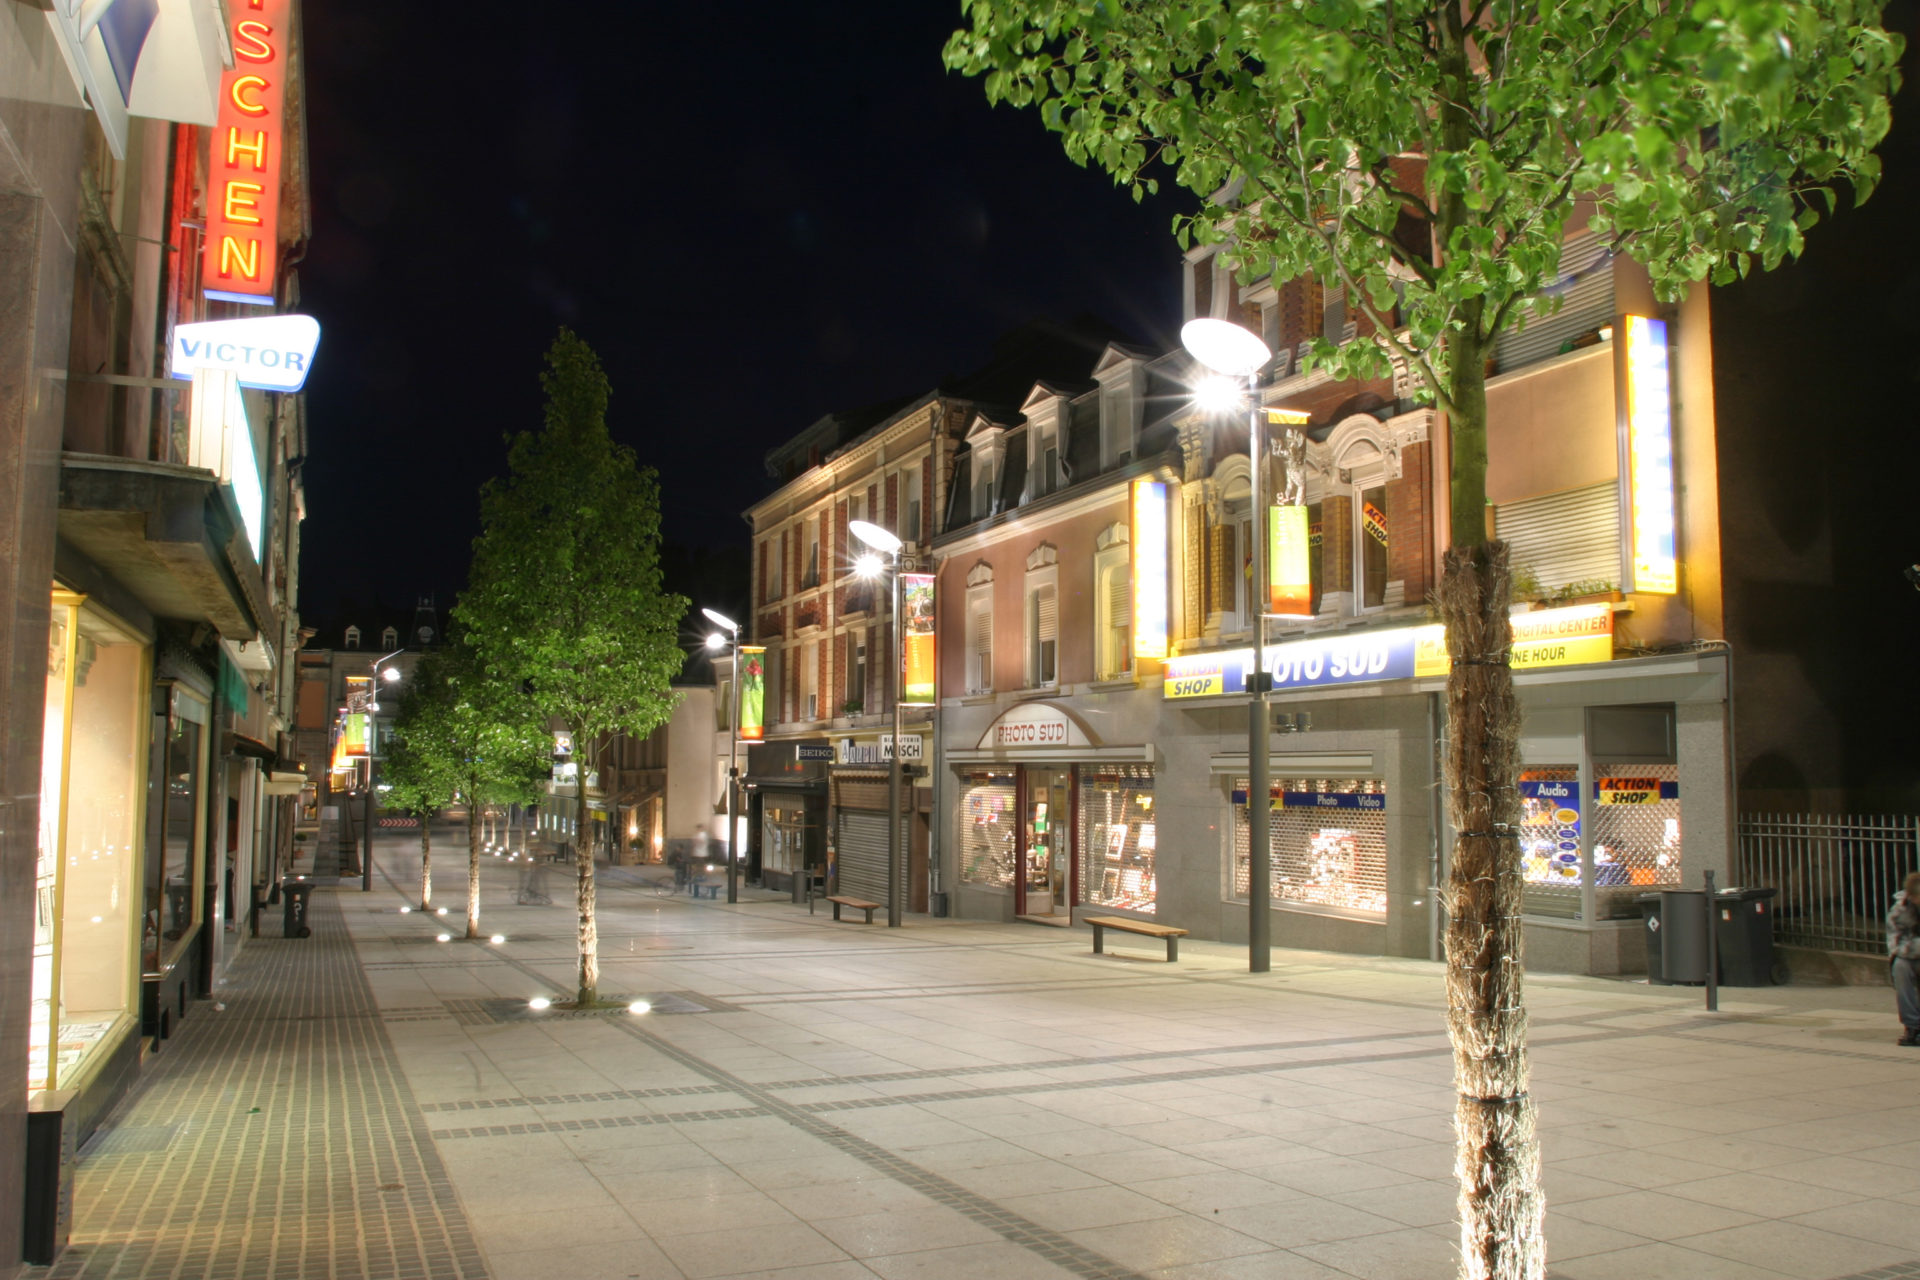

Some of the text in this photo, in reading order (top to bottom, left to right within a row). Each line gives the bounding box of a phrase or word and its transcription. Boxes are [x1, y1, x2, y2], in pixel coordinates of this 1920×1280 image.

[218, 0, 275, 283] SCHEN
[179, 337, 304, 372] VICTOR
[1366, 508, 1388, 531] ACTI
[1511, 615, 1607, 638] DIGITAL CENTER
[1330, 643, 1390, 678] SUD
[1533, 646, 1566, 662] HOUR
[1174, 678, 1212, 696] SHOP
[998, 723, 1065, 742] PHOTO SUD
[799, 748, 834, 758] SEIKO
[883, 744, 920, 757] MISCH
[1537, 783, 1569, 797] Audio
[1605, 778, 1656, 790] ACTION
[1317, 794, 1381, 807] Photo Video
[1611, 791, 1649, 804] SHOP
